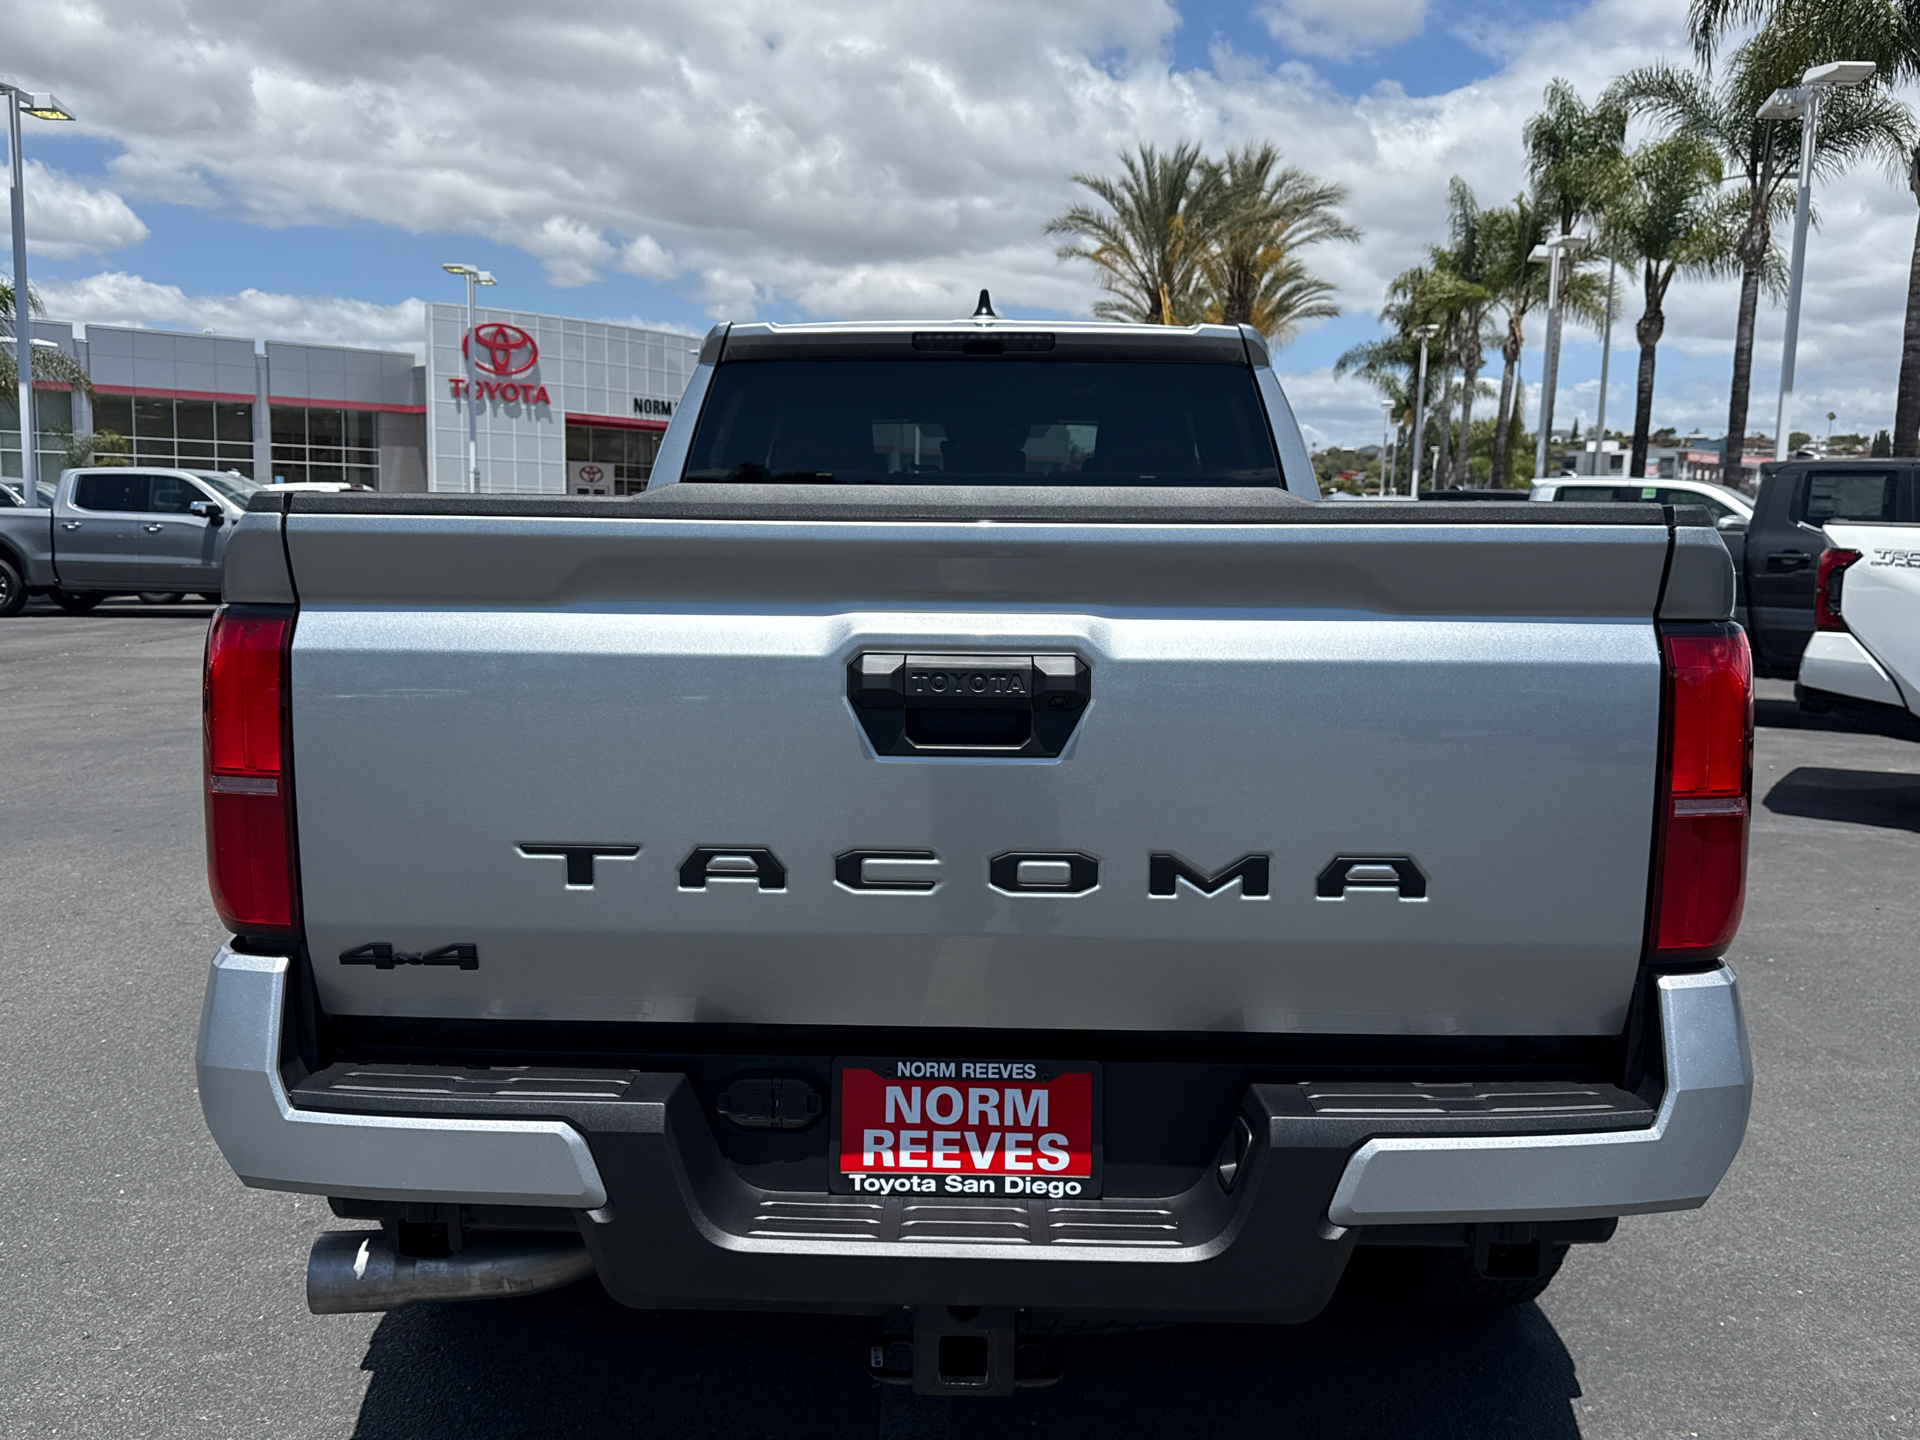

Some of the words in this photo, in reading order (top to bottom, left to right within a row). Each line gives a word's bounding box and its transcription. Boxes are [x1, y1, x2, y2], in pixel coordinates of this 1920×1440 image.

[448, 377, 551, 405] TOYOTA
[633, 397, 672, 416] NORM
[911, 672, 1027, 694] TOYOTA
[515, 843, 1429, 902] TACOMA
[897, 1061, 956, 1078] NORM
[961, 1063, 1037, 1080] REEVES
[884, 1085, 1049, 1128] NORM
[862, 1128, 1071, 1172] REEVES
[848, 1173, 937, 1196] Toyota
[944, 1174, 996, 1194] San
[1003, 1176, 1082, 1199] Diego
